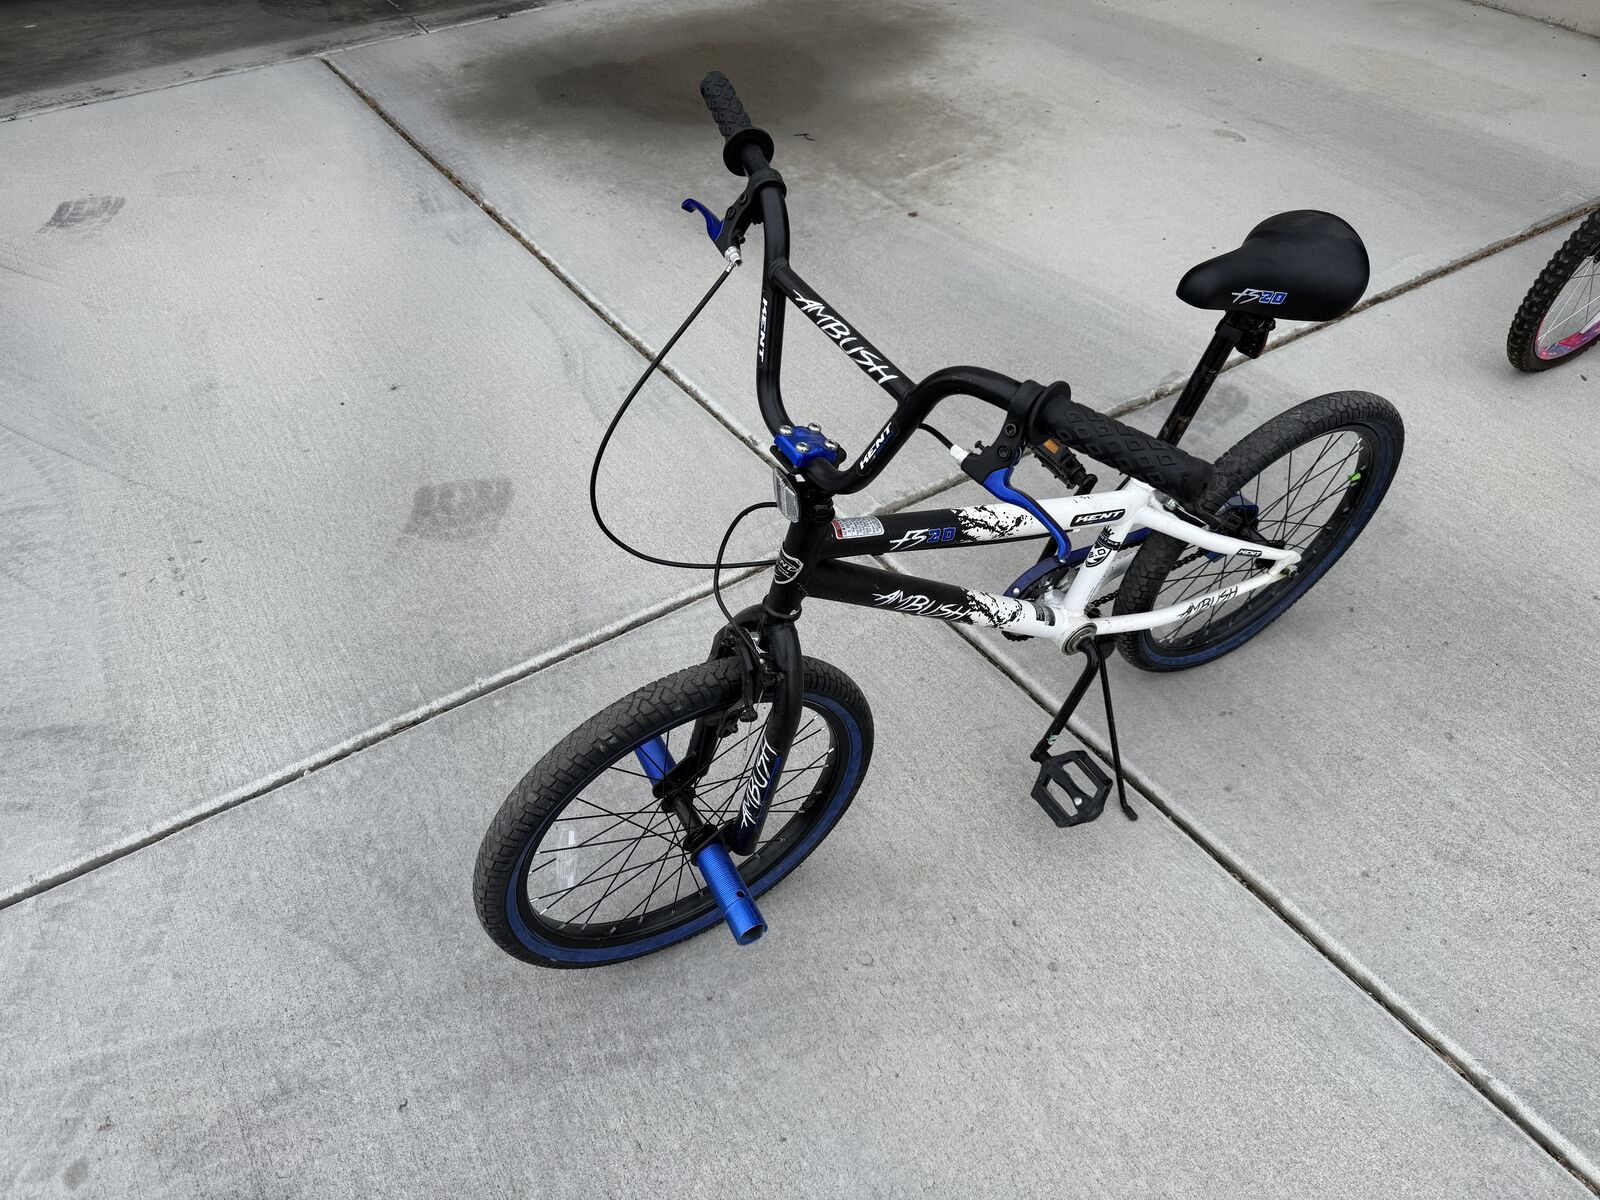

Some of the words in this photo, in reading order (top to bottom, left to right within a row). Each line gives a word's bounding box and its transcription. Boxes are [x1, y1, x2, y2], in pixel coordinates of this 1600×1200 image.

[758, 297, 768, 363] KENT
[793, 289, 899, 384] AMBUSH
[859, 421, 892, 470] KENT
[1074, 510, 1124, 523] KENT
[1239, 549, 1262, 557] KENT
[872, 589, 972, 621] AMBUSH
[1177, 586, 1239, 618] AMBUSH
